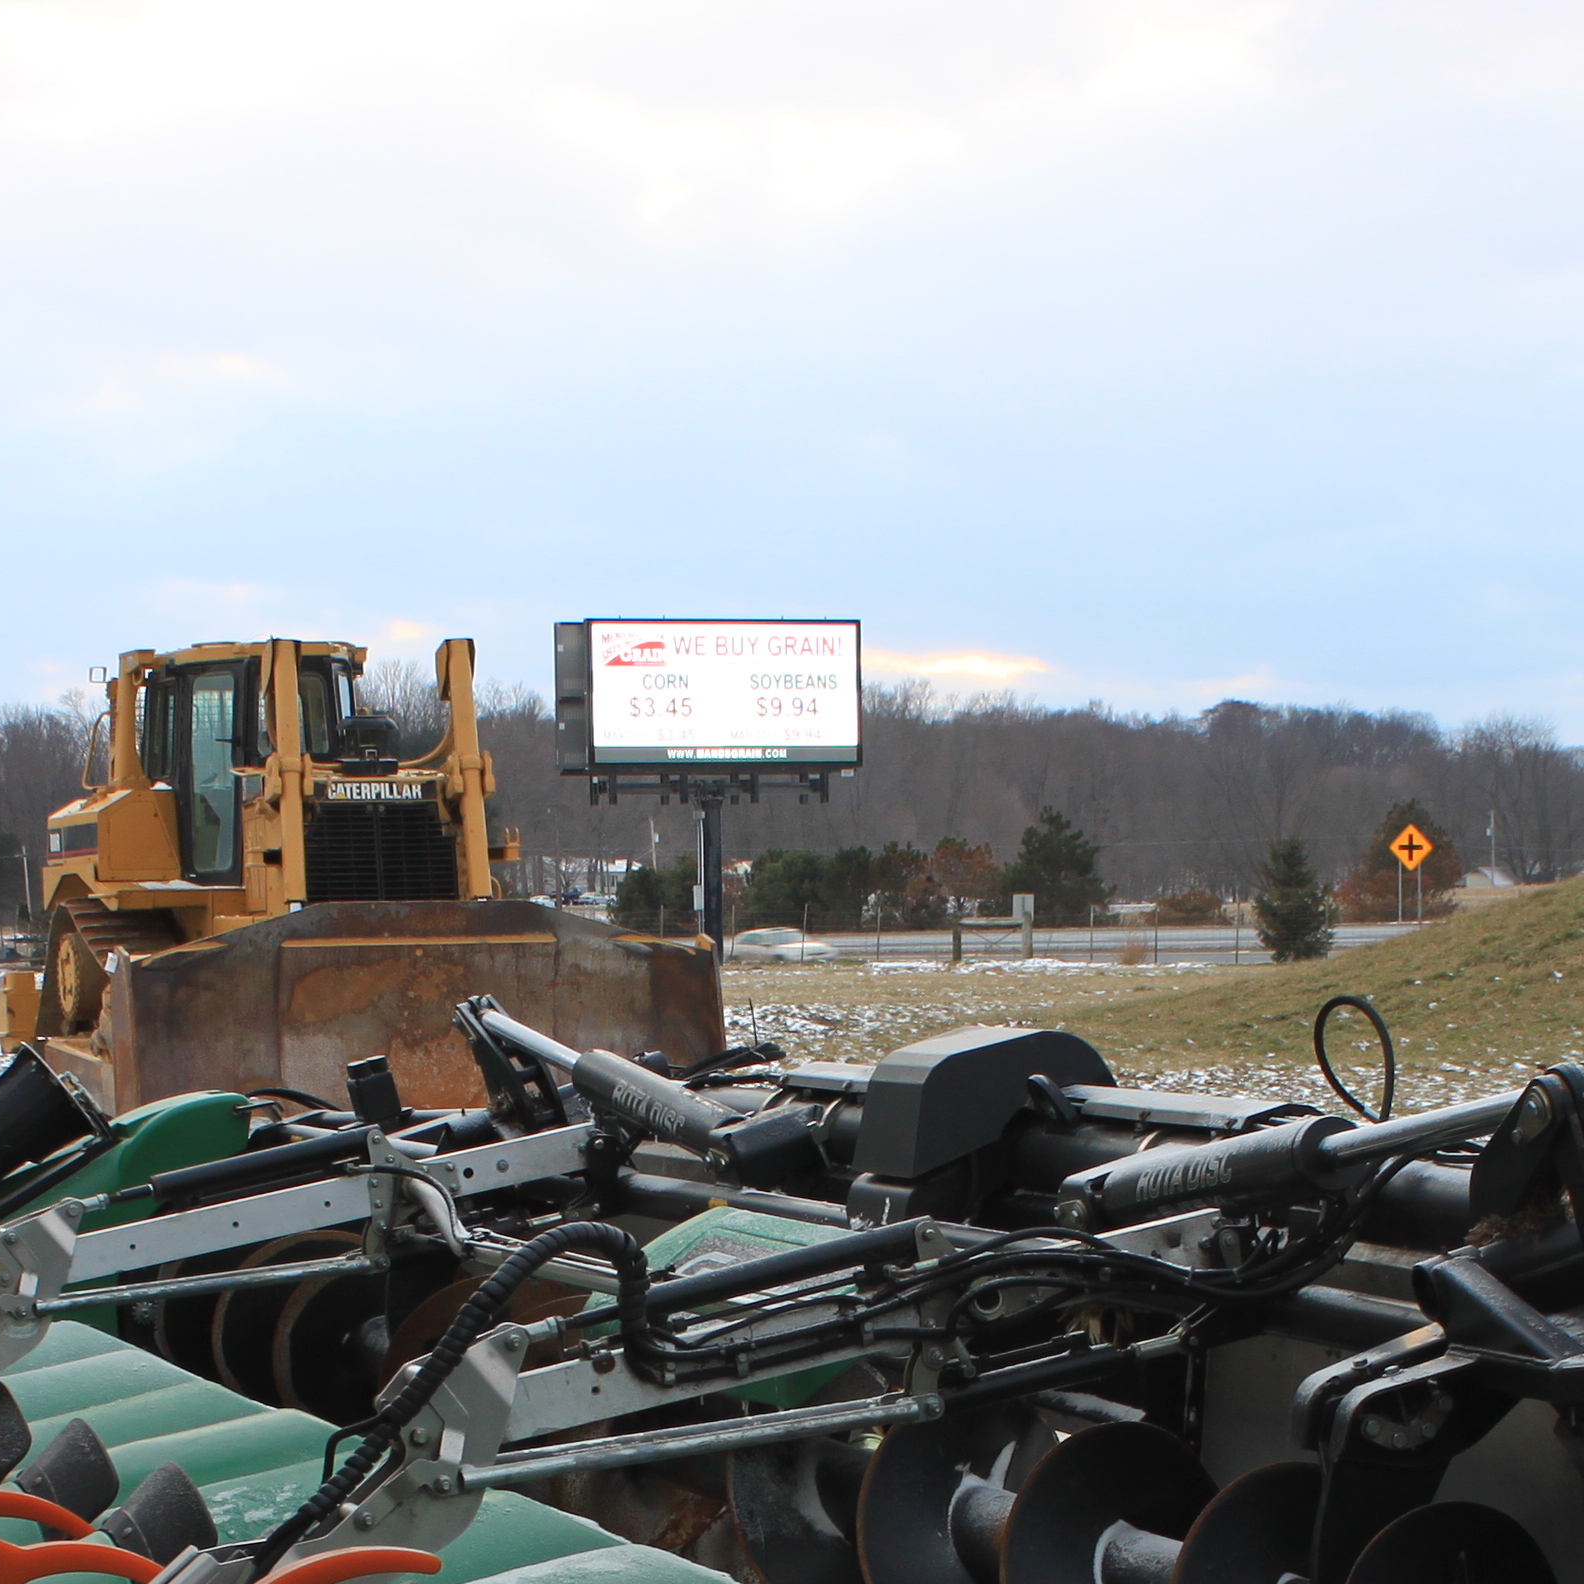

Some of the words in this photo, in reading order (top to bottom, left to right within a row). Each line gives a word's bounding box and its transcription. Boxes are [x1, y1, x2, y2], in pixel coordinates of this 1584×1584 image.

[673, 636, 706, 656] WE
[716, 636, 758, 656] BUY
[768, 636, 841, 656] GRAIN!
[642, 674, 689, 690] CORN
[750, 674, 838, 690] SOYBEANS
[629, 696, 693, 718] $3.45
[757, 696, 819, 718] $9.94
[327, 782, 423, 800] CATERPILLAR
[612, 1079, 652, 1119] ROTA
[649, 1101, 686, 1137] DISC
